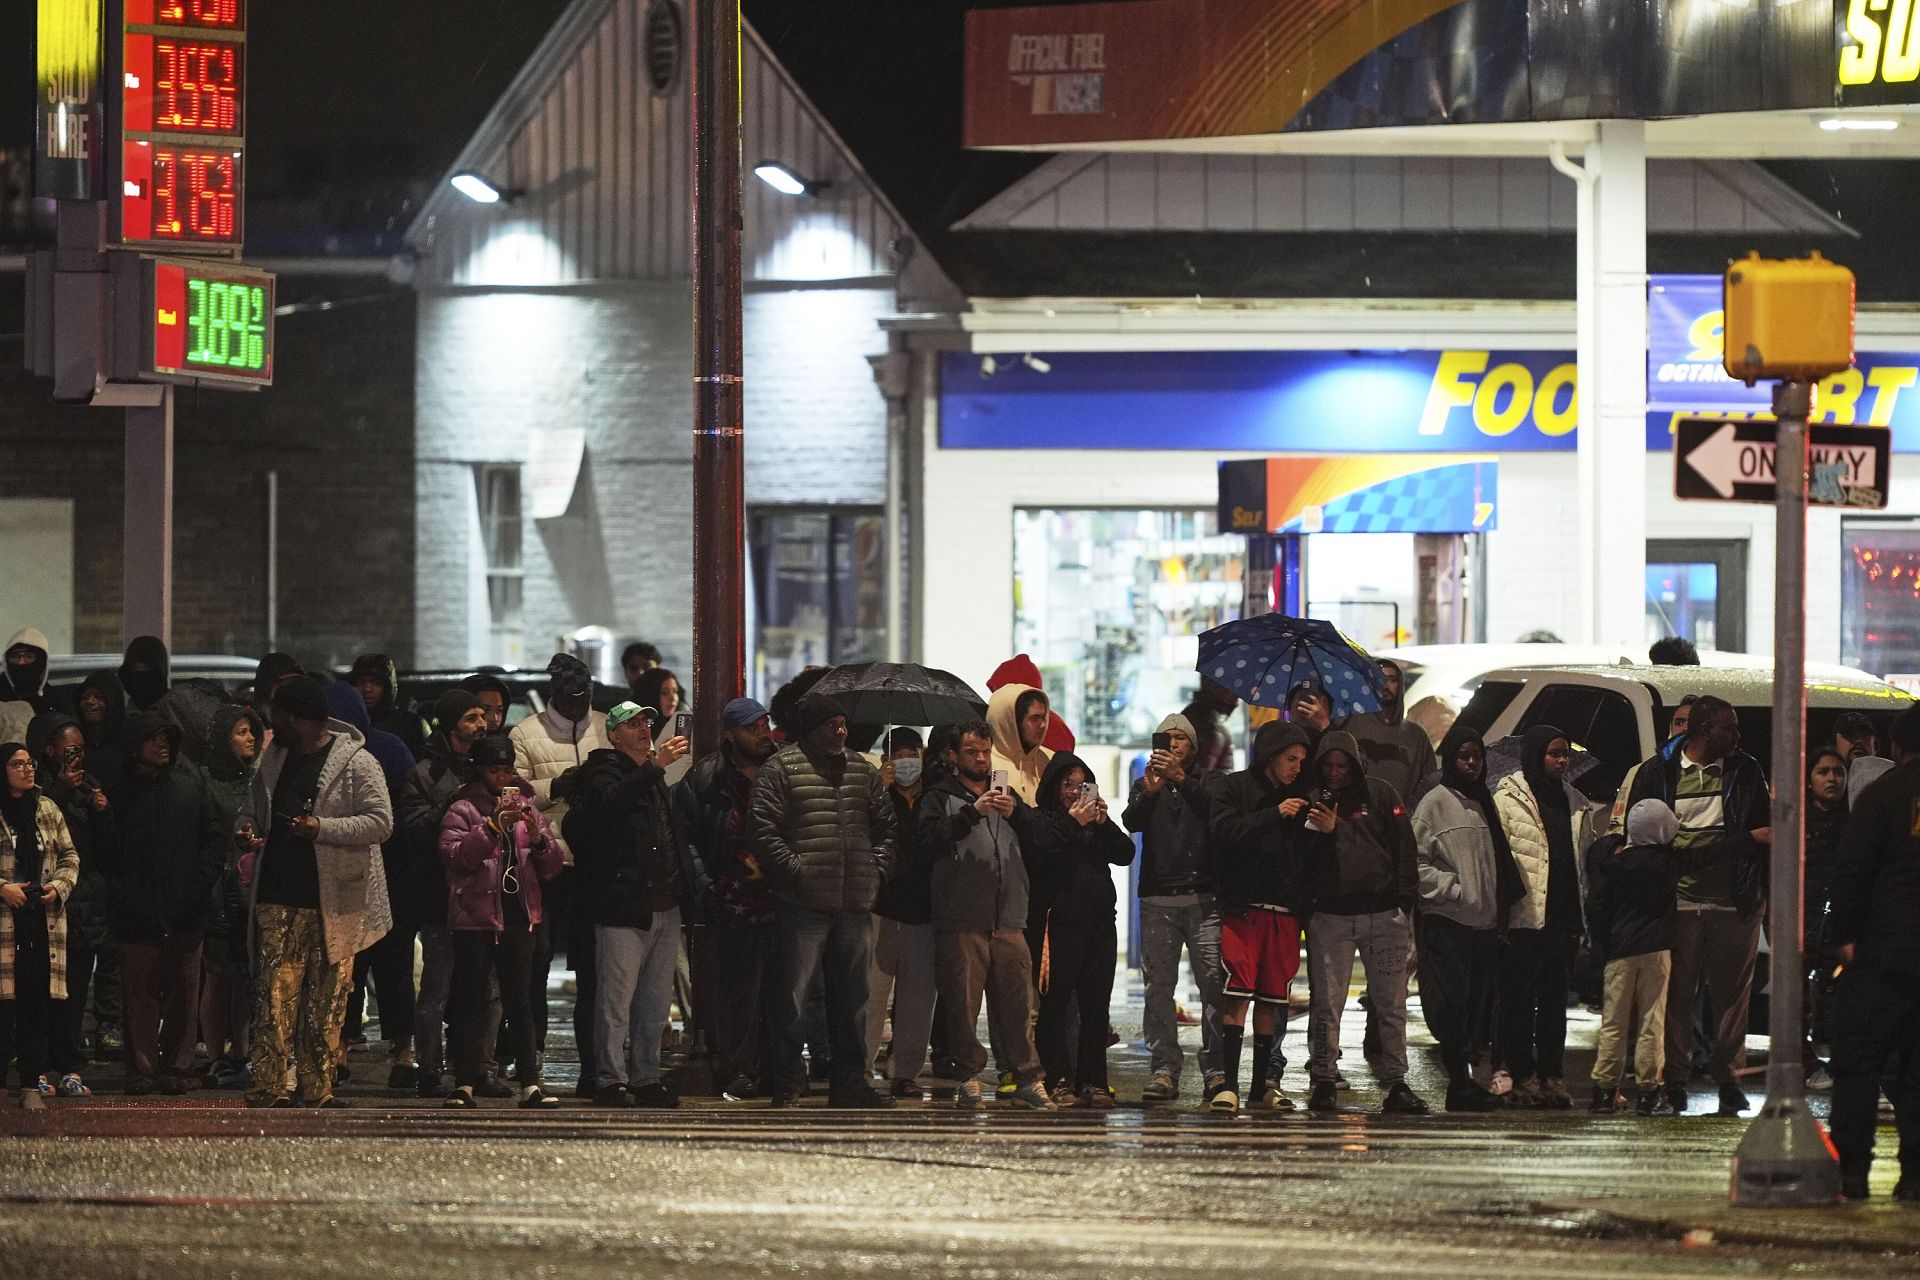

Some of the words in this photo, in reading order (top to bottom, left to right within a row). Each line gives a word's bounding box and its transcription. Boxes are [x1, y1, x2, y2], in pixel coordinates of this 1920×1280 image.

[47, 112, 89, 159] HRE
[1657, 362, 1742, 383] OCTAN
[1418, 350, 1578, 436] FOO
[1739, 446, 1777, 478] ON
